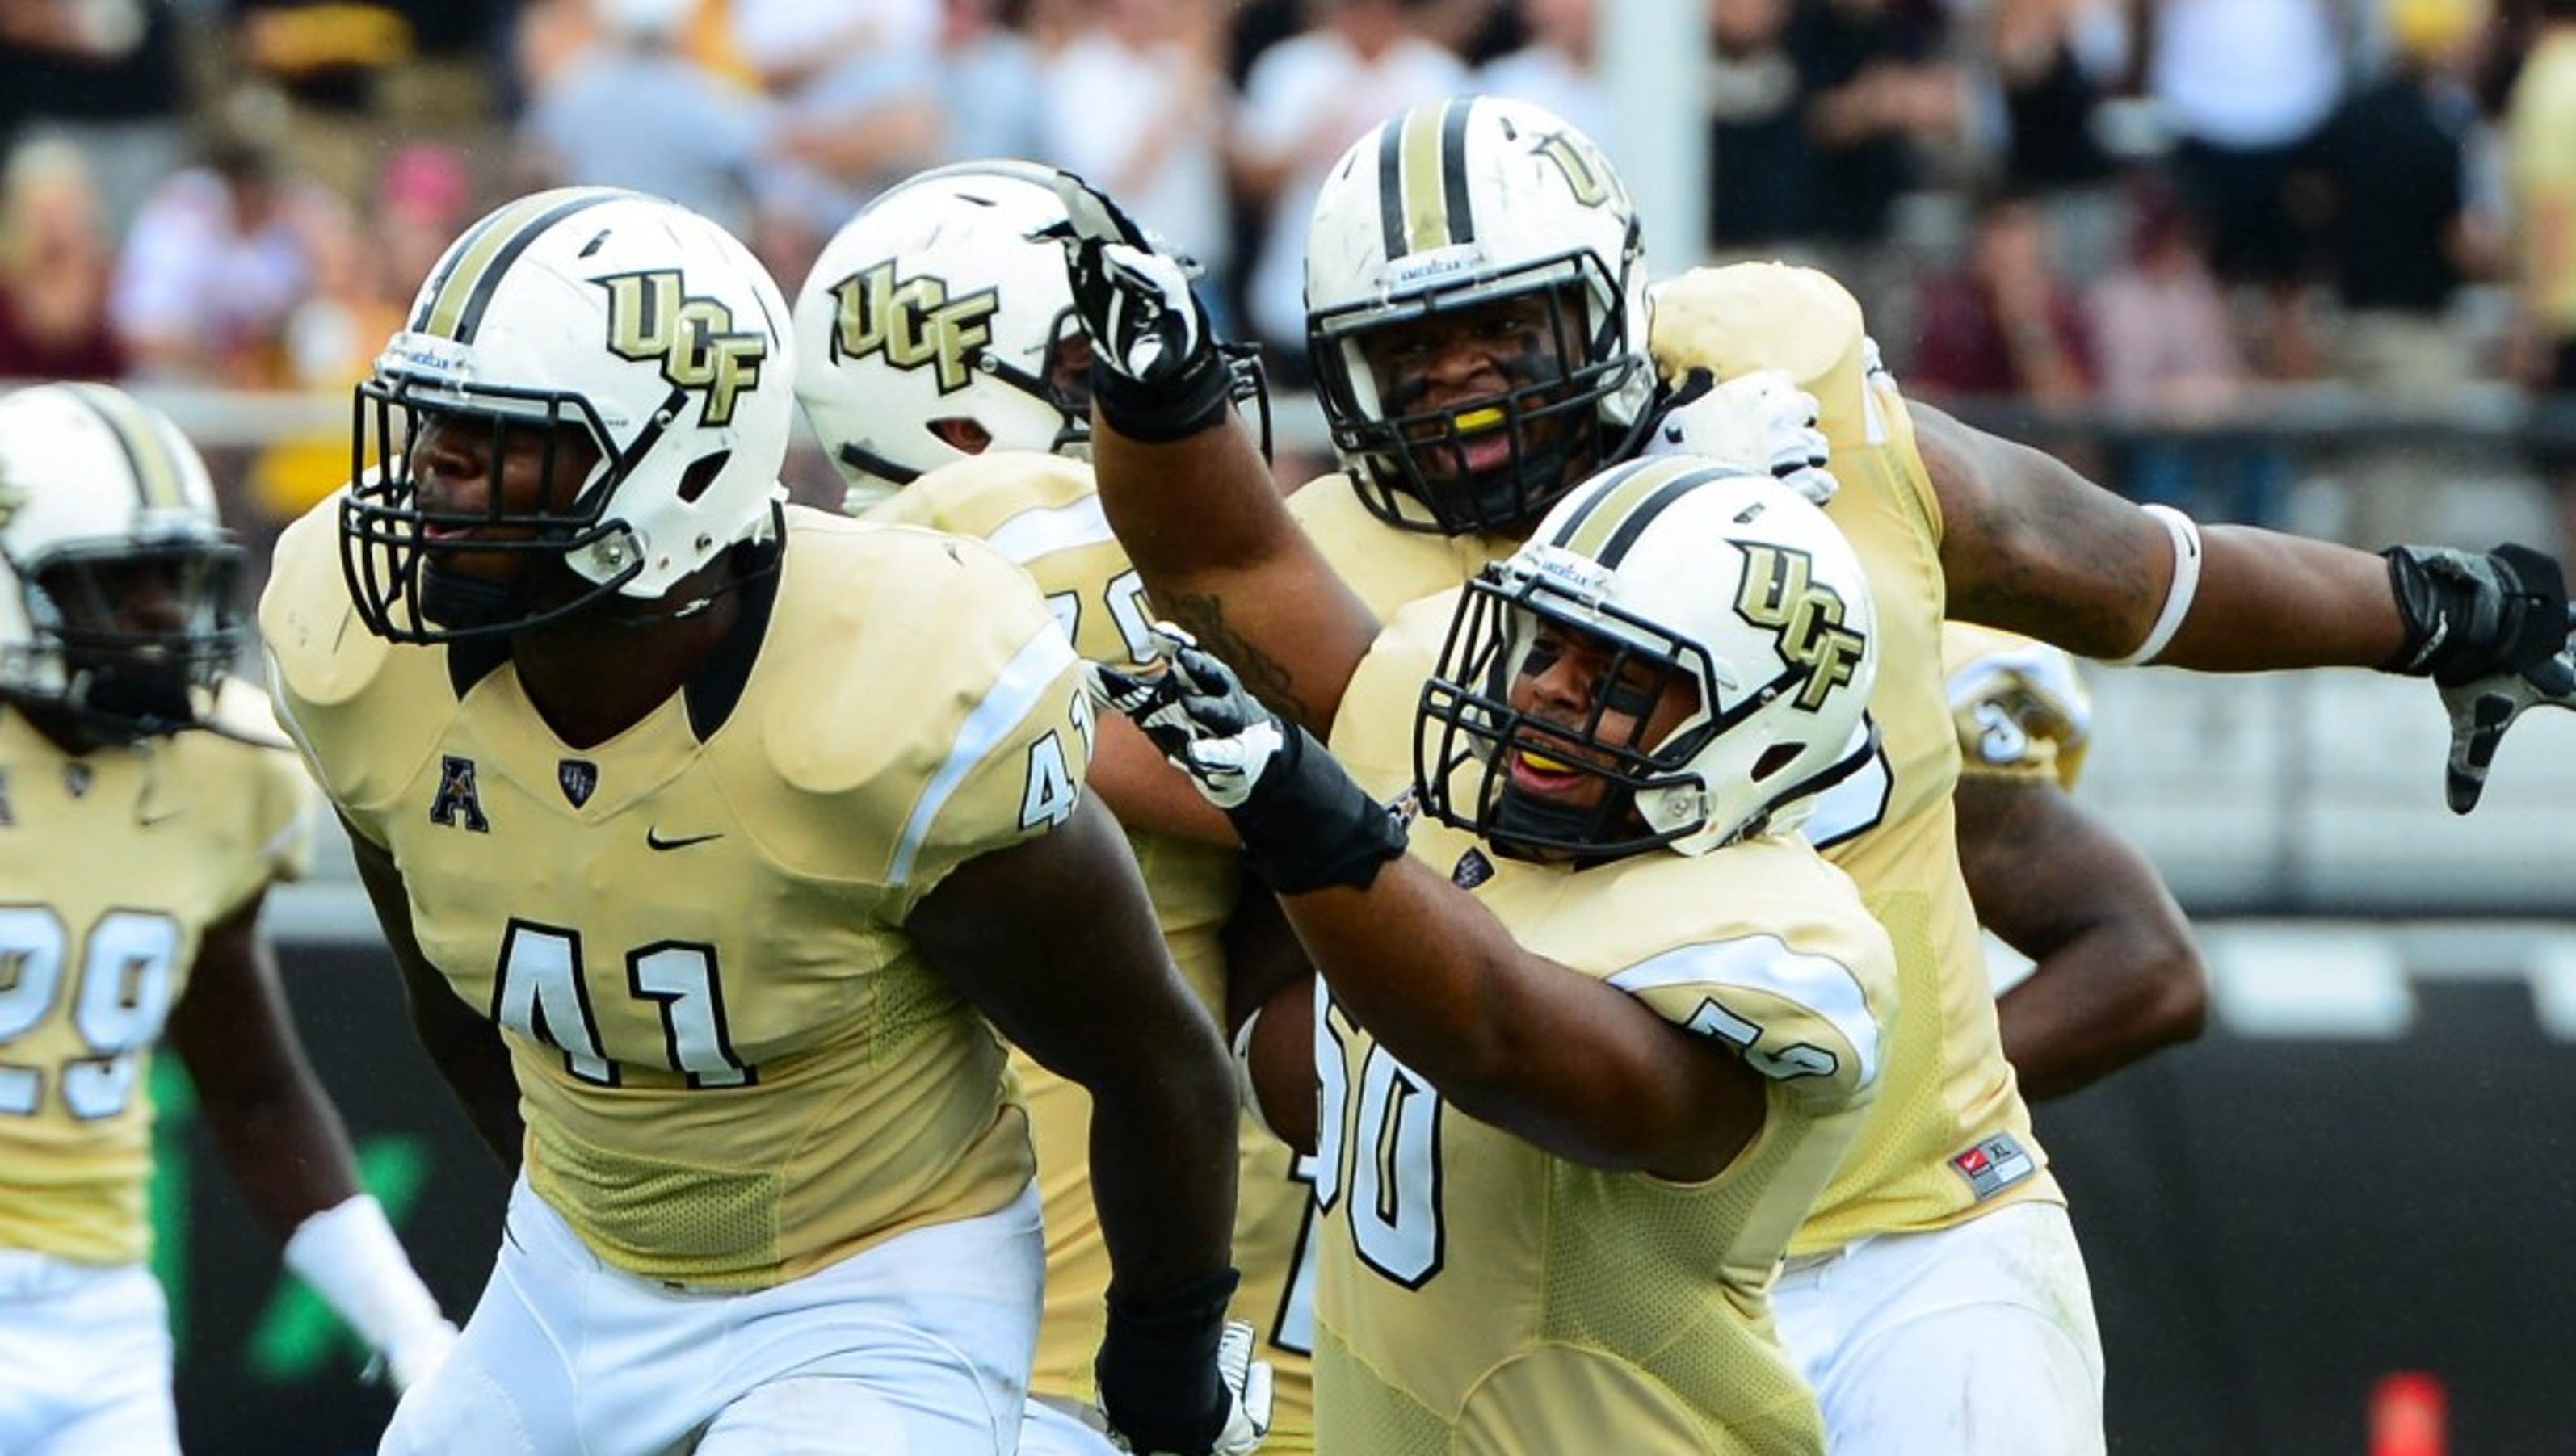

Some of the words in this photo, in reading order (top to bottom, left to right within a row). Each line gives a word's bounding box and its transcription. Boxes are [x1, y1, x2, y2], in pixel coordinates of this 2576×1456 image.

[584, 268, 767, 429] UCF
[825, 255, 1000, 397] UCF
[1724, 539, 1865, 713] UCF
[0, 903, 181, 1122] 29
[490, 917, 758, 1089] 41
[1990, 1142, 2011, 1160] XL
